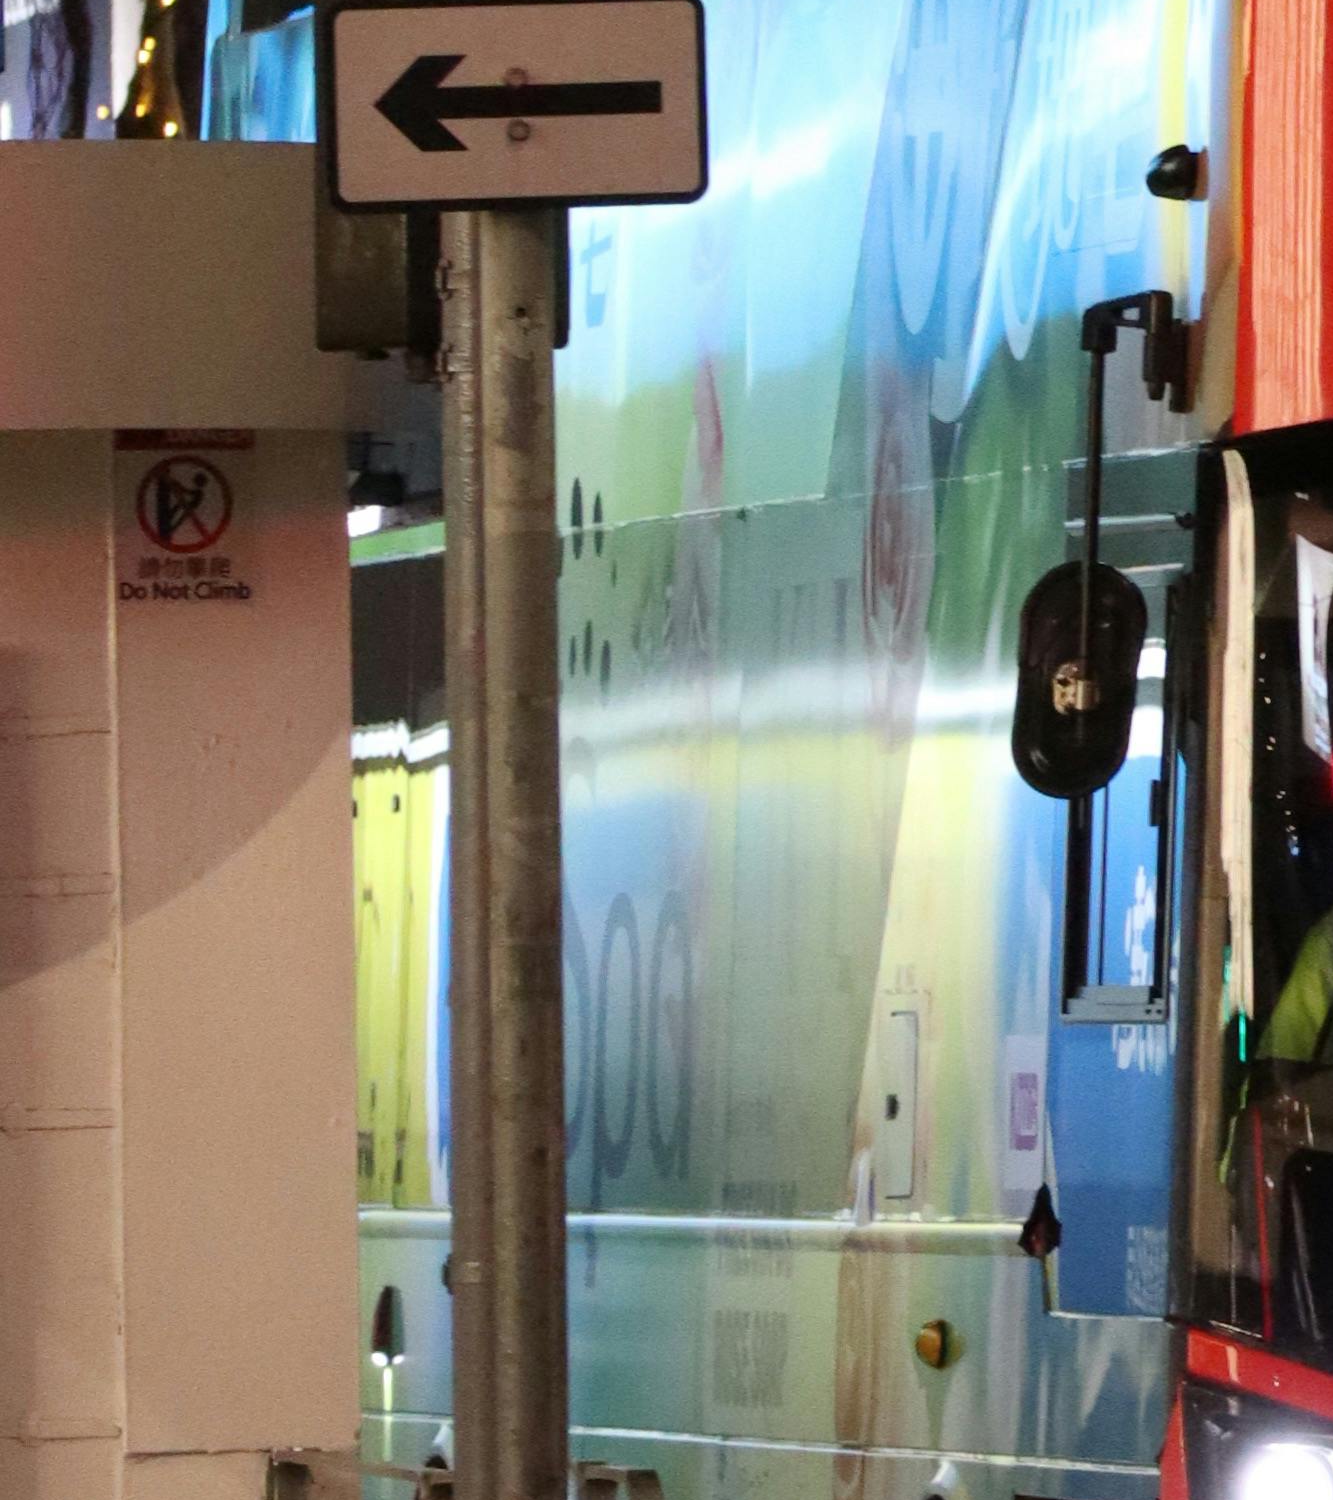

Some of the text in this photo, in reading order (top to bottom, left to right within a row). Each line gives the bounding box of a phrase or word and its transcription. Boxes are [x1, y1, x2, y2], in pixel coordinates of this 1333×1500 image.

[119, 581, 252, 601] Do Not Climb
